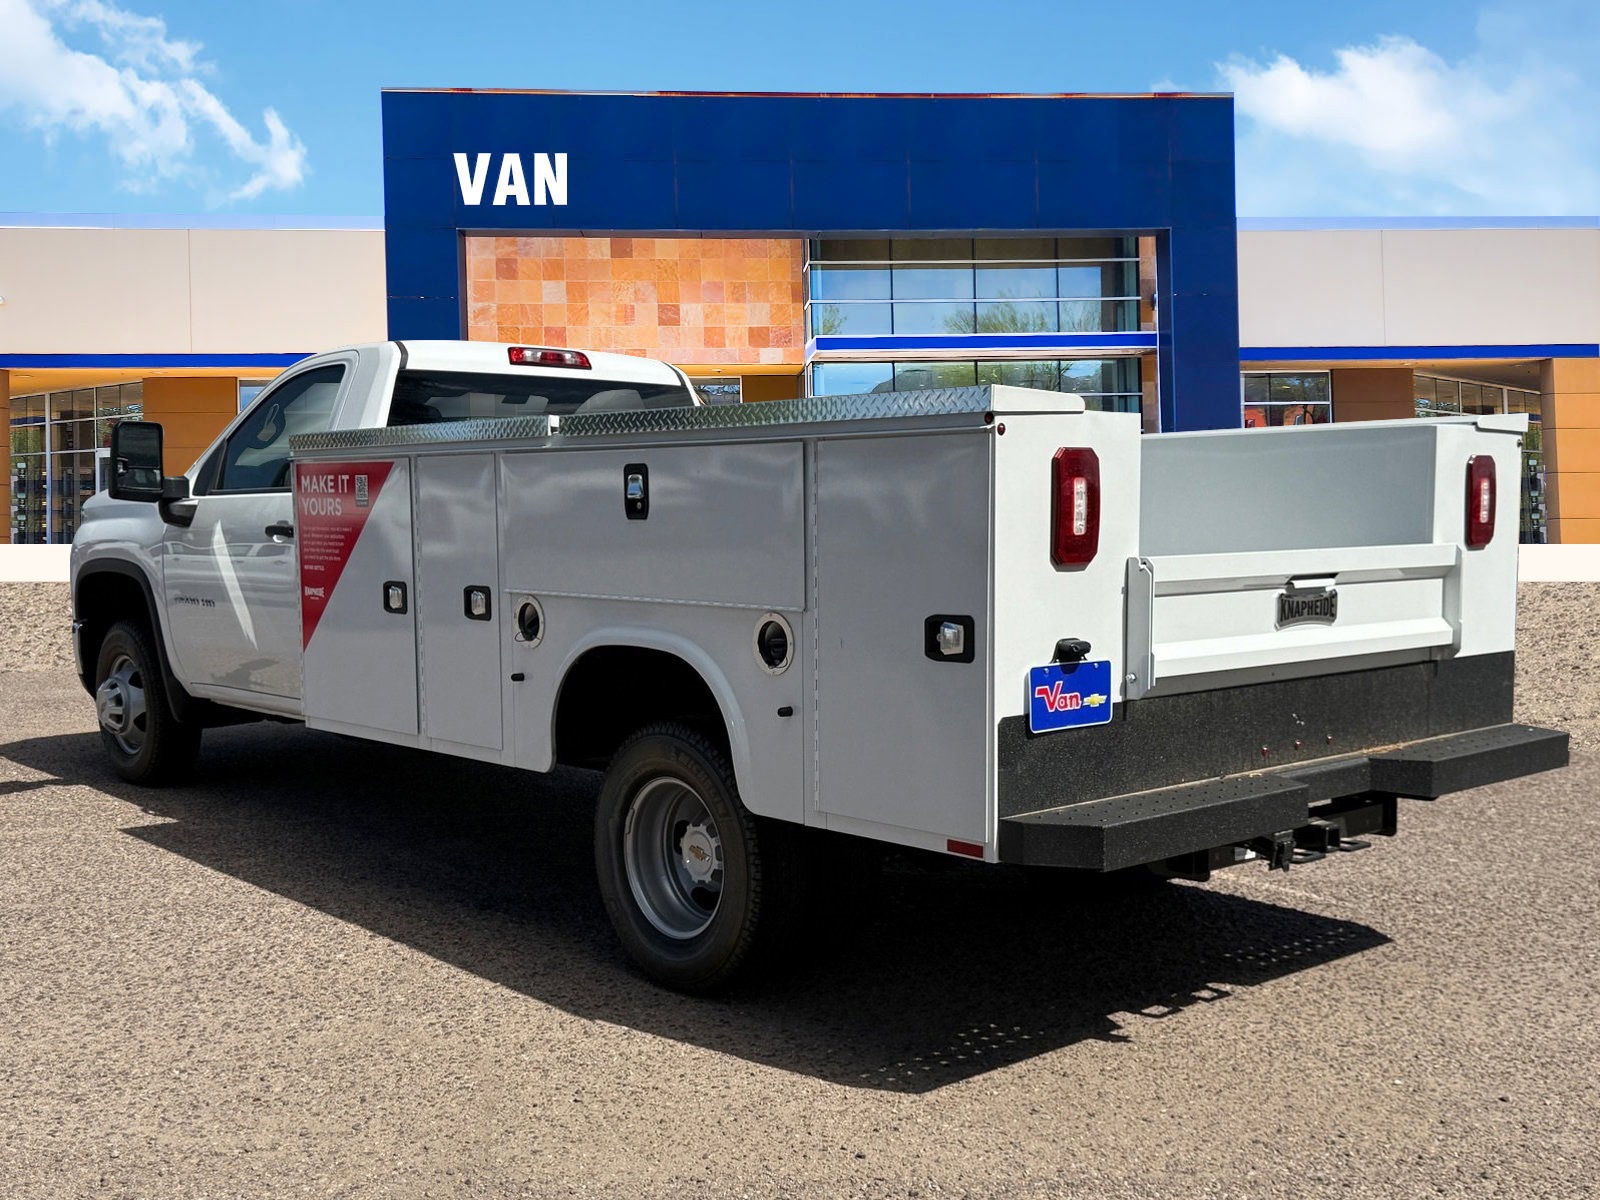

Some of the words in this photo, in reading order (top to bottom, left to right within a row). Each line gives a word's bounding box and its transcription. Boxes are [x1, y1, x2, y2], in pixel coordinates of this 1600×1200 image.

[453, 153, 568, 205] VAN
[301, 475, 335, 493] MAKE
[338, 475, 349, 493] IT
[301, 498, 342, 516] YOURS
[1279, 595, 1336, 622] KNAPHEIDE
[1035, 681, 1082, 712] Van
